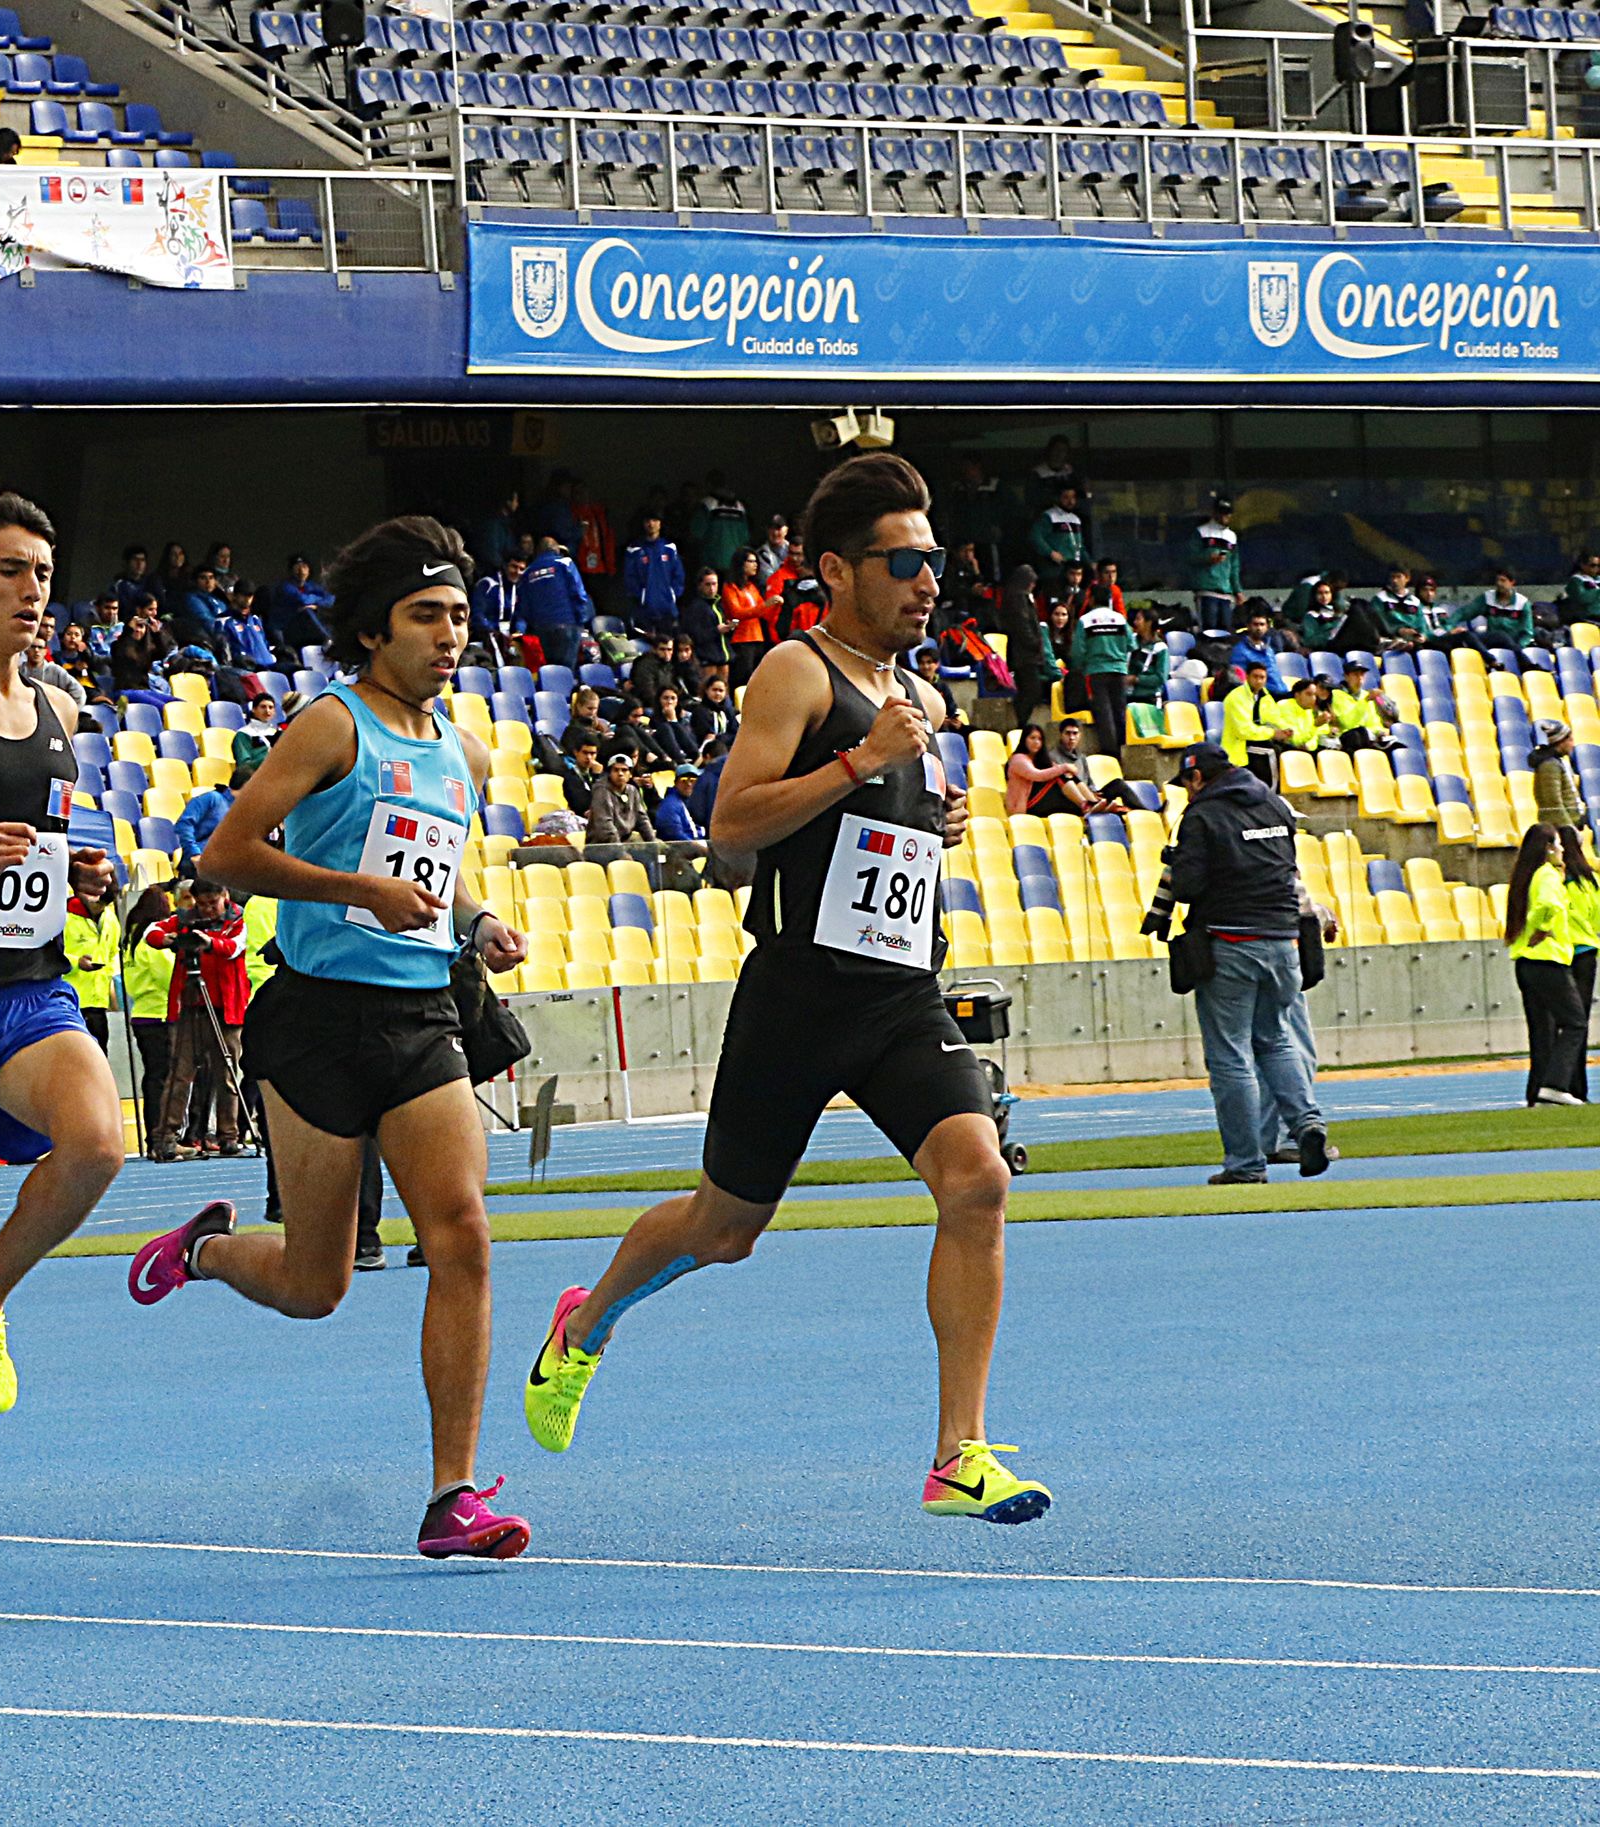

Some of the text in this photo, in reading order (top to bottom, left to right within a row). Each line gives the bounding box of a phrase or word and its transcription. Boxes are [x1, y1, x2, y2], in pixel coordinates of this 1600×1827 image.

[575, 237, 860, 353] Concepción
[1305, 251, 1560, 359] Concepción
[742, 336, 859, 356] Ciudad de Todos
[1454, 340, 1560, 359] Ciudad de Todos
[376, 421, 460, 448] SALIDA
[385, 850, 452, 898] 187
[850, 866, 926, 925] 180
